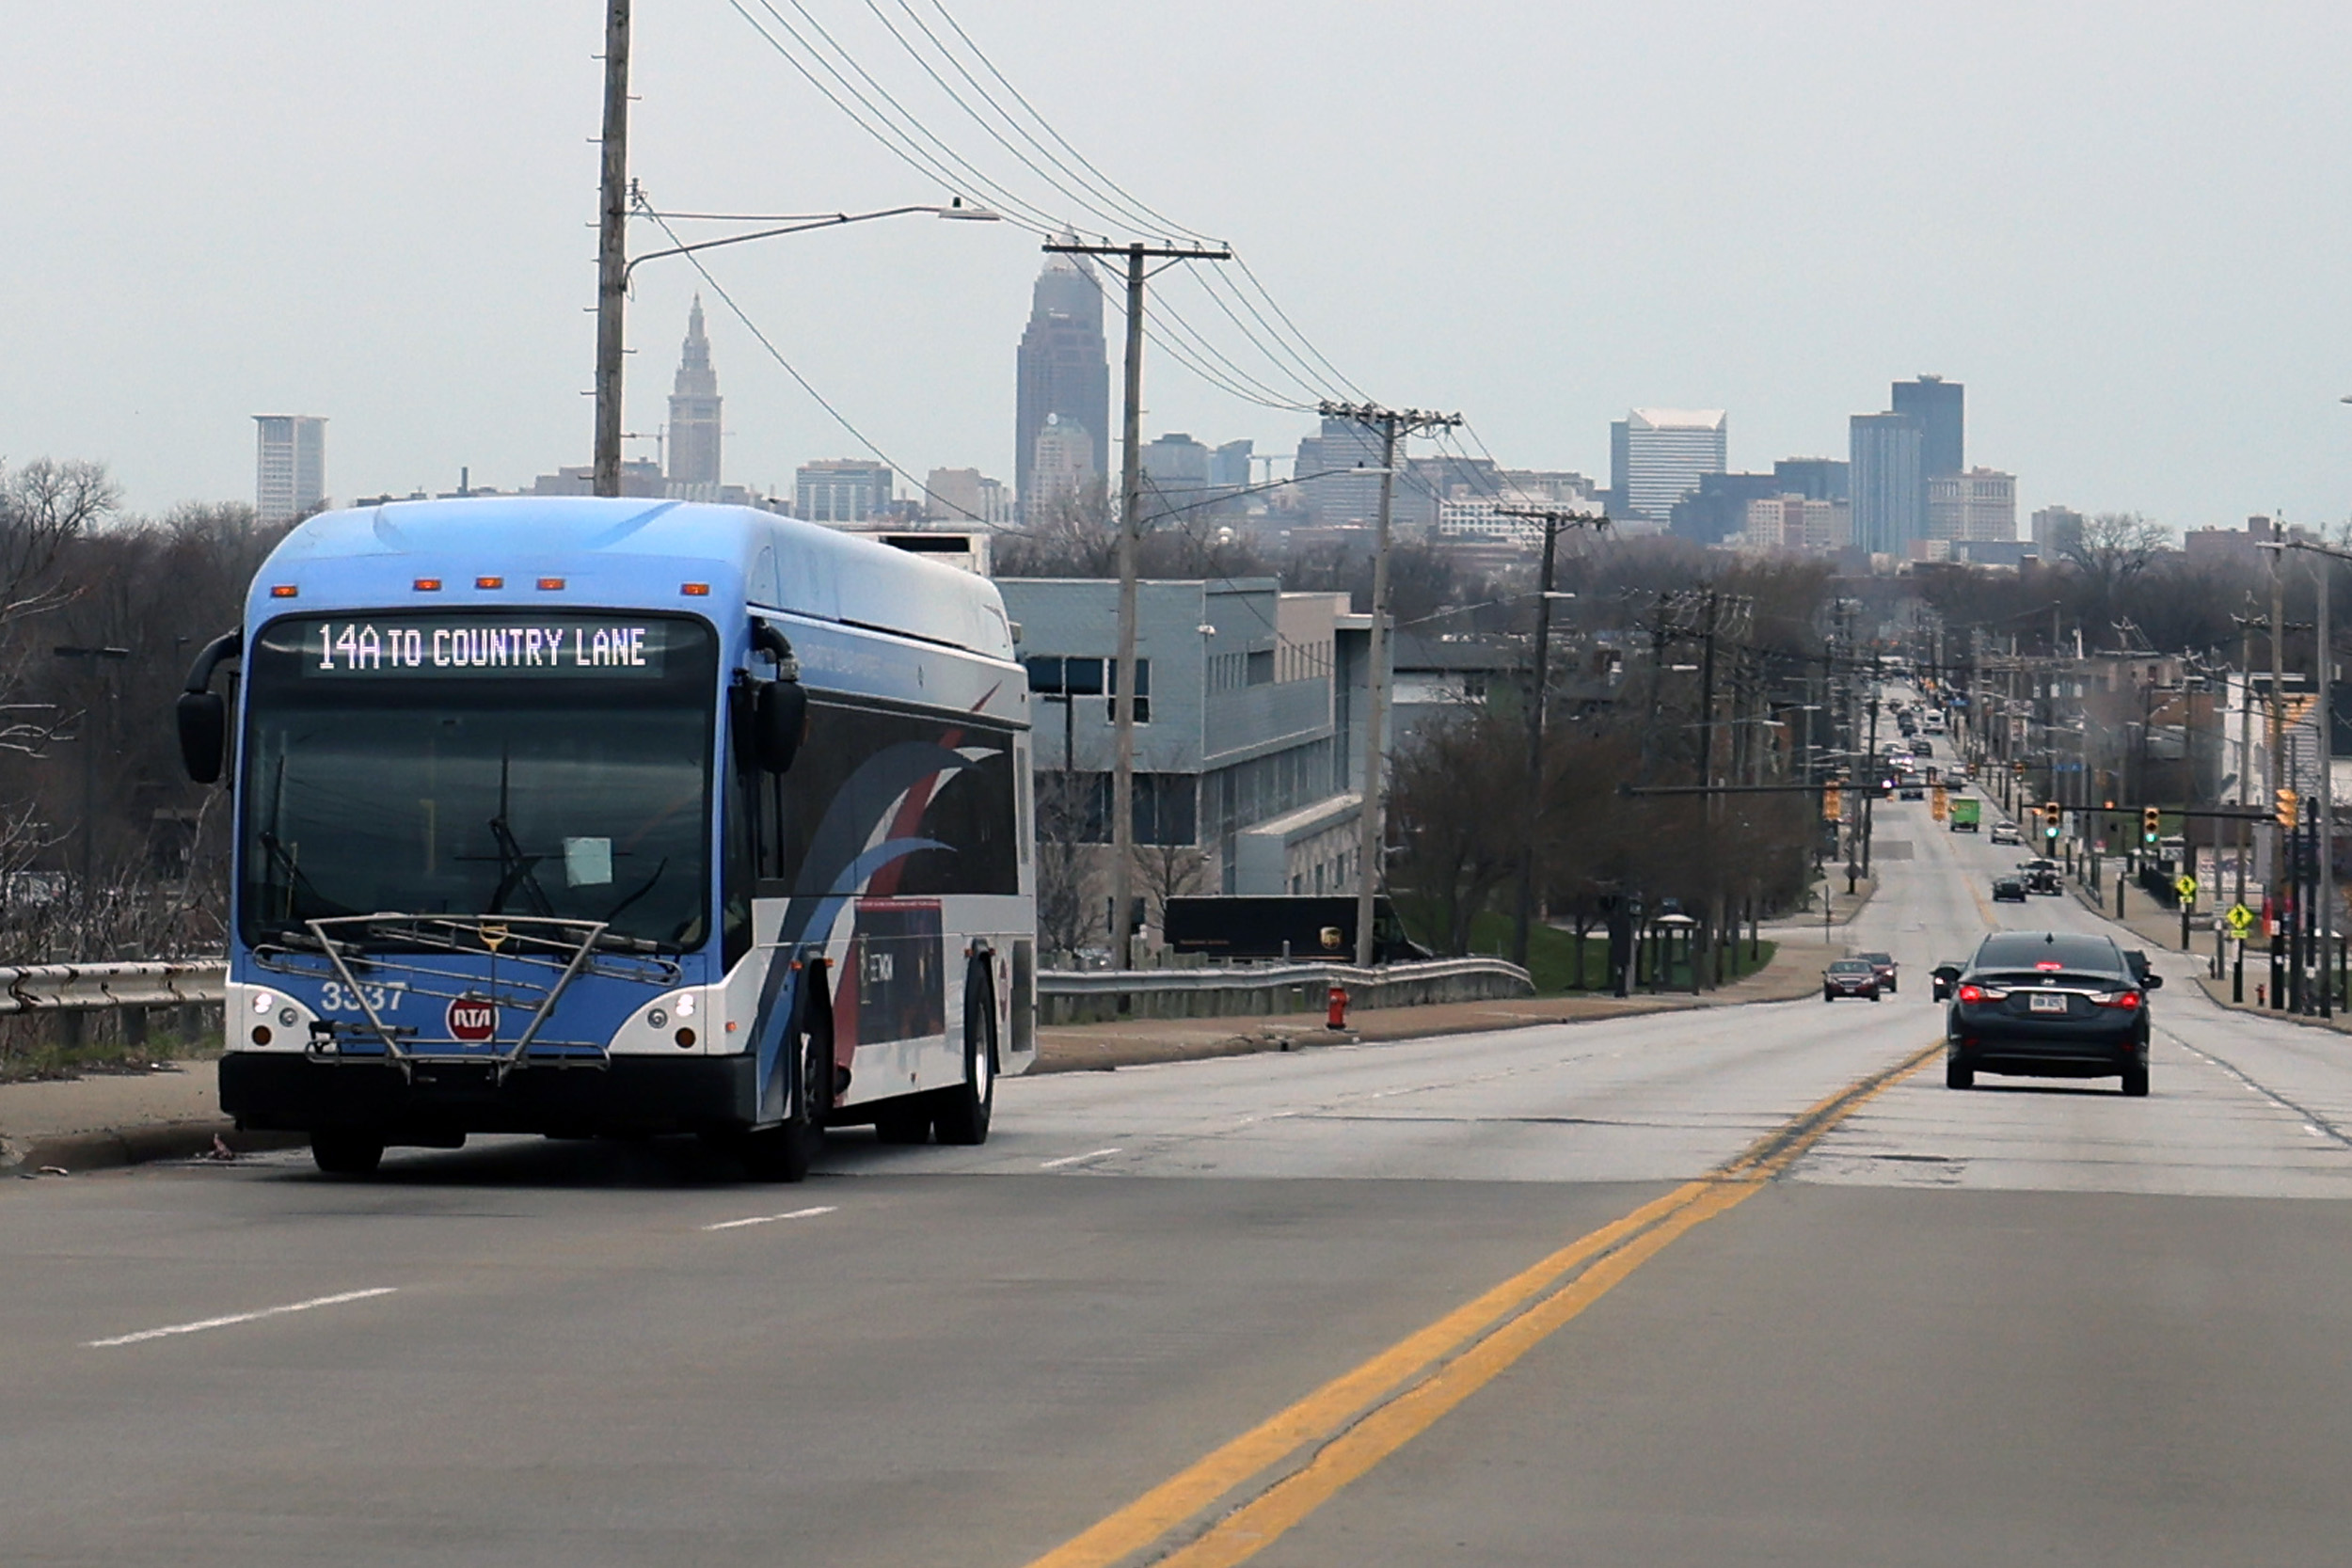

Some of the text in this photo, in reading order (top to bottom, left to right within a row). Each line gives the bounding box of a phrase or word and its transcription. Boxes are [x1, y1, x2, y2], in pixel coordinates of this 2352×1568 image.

[318, 624, 646, 670] 14A TO COUNTRY LANE
[321, 981, 406, 1011] 3337
[453, 1008, 492, 1028] RTA
